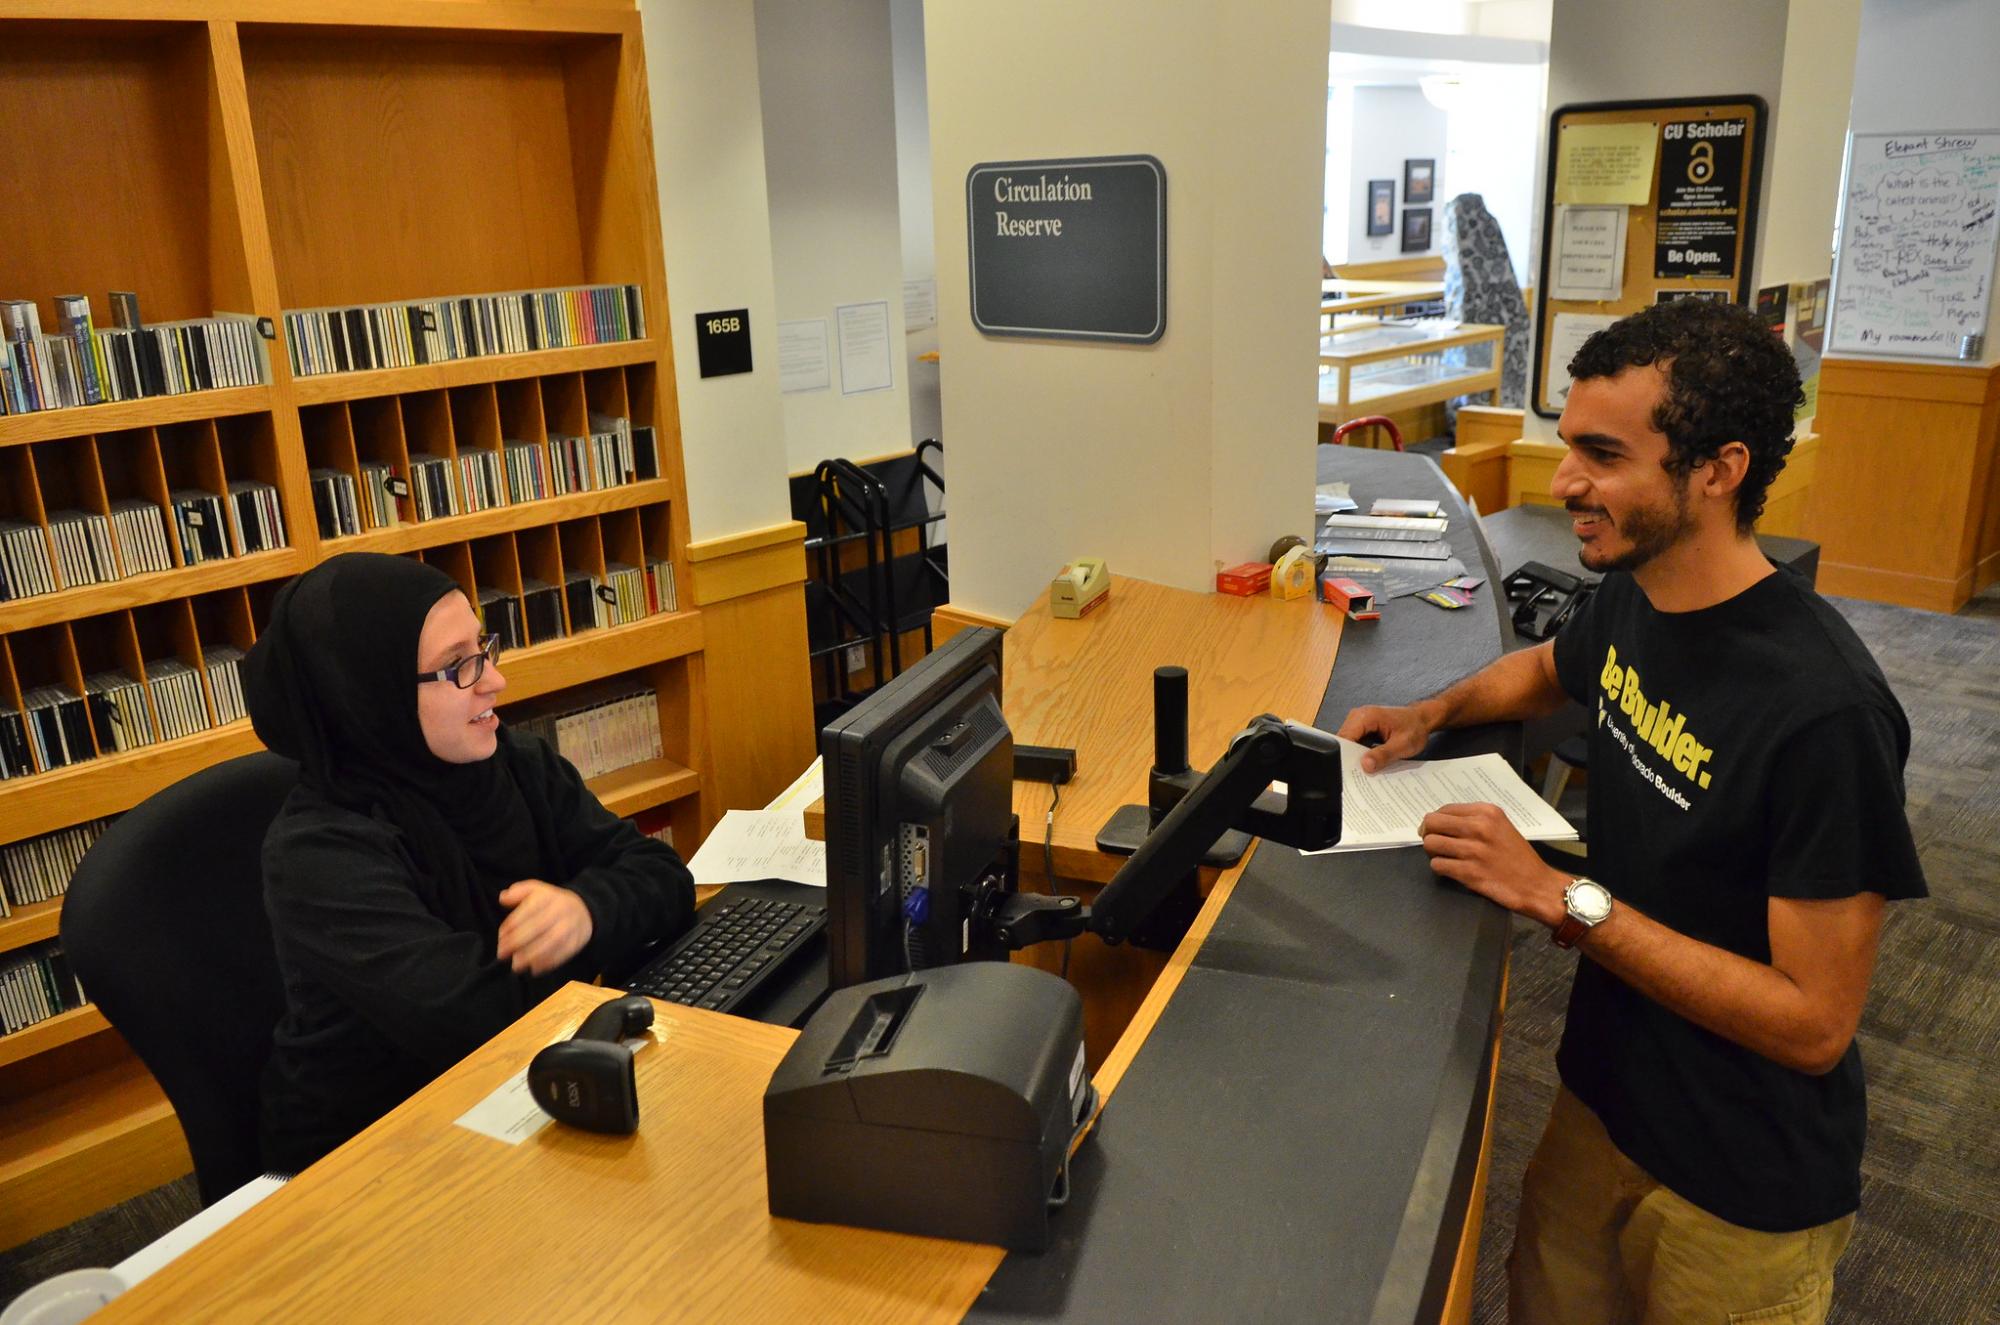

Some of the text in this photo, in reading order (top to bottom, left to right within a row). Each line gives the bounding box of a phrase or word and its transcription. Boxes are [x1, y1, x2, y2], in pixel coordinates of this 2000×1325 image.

[1663, 121, 1745, 140] CU Scholar
[994, 174, 1093, 203] Circulation
[995, 211, 1063, 237] Reserve
[1667, 249, 1721, 265] Be Open.
[706, 317, 741, 335] 165B
[1600, 644, 1714, 790] Be Boulder.
[1655, 775, 1692, 811] Boulder
